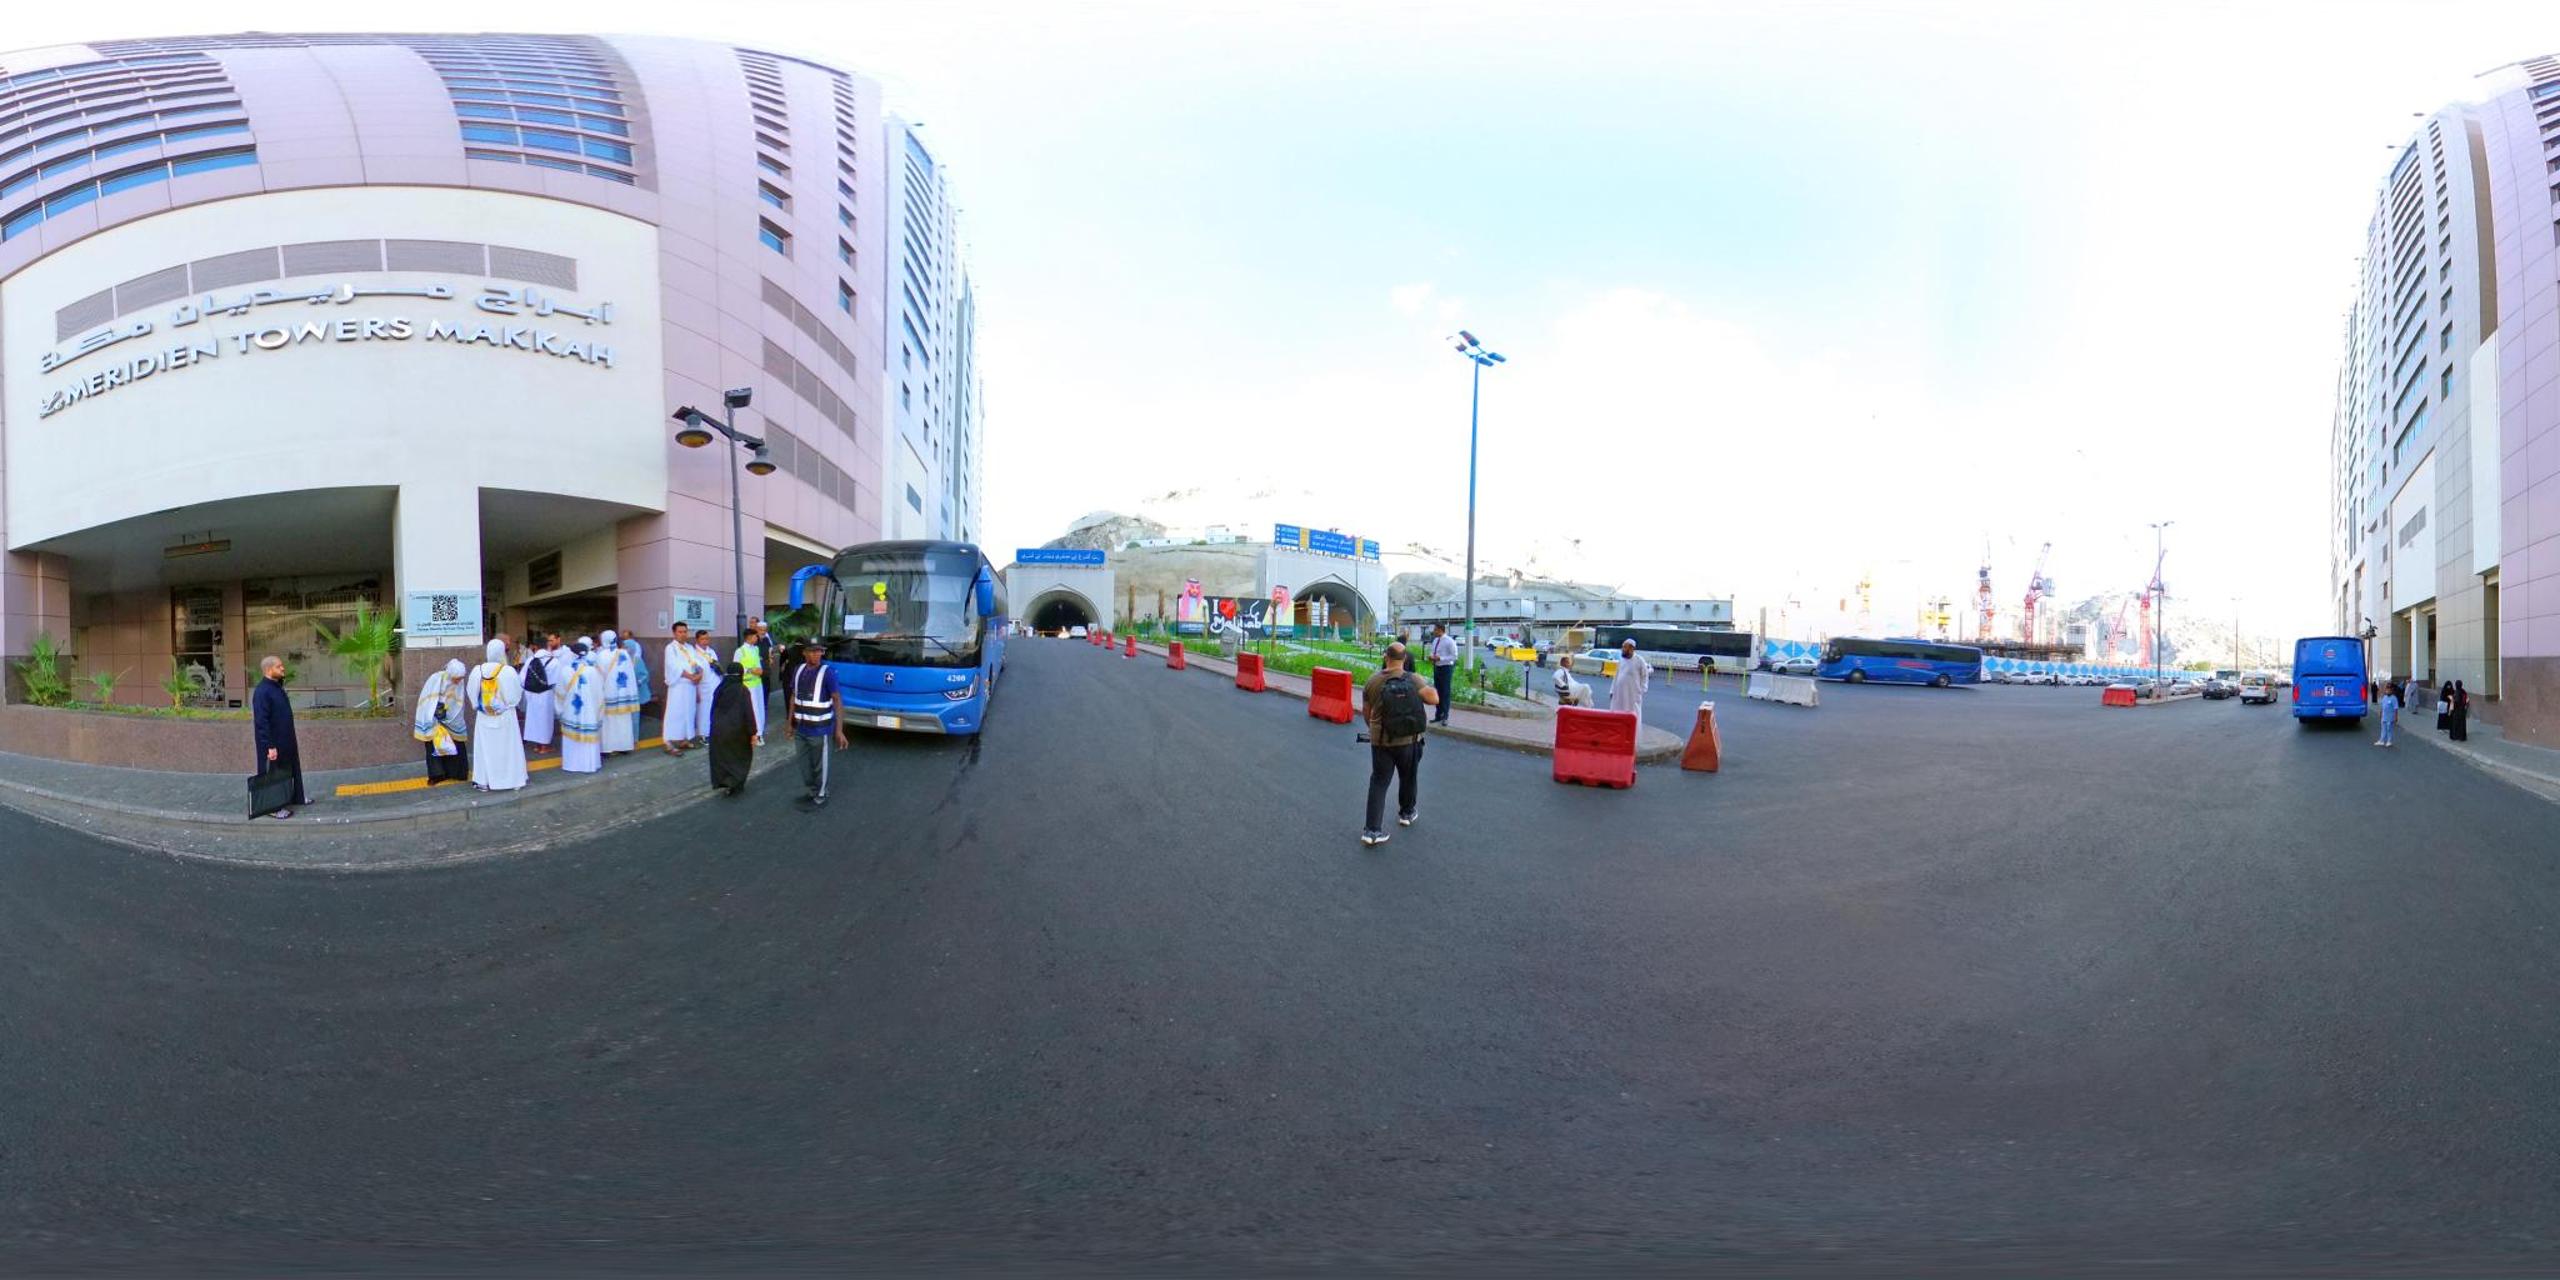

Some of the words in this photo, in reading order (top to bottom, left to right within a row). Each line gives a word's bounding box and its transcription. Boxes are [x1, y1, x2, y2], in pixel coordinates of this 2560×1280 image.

[171, 283, 454, 327] مريديان
[41, 322, 152, 375] مكة
[66, 338, 219, 407] MERIDIEN
[232, 317, 414, 355] TOWERS
[425, 319, 615, 369] MAKKAH
[1212, 598, 1220, 615] I
